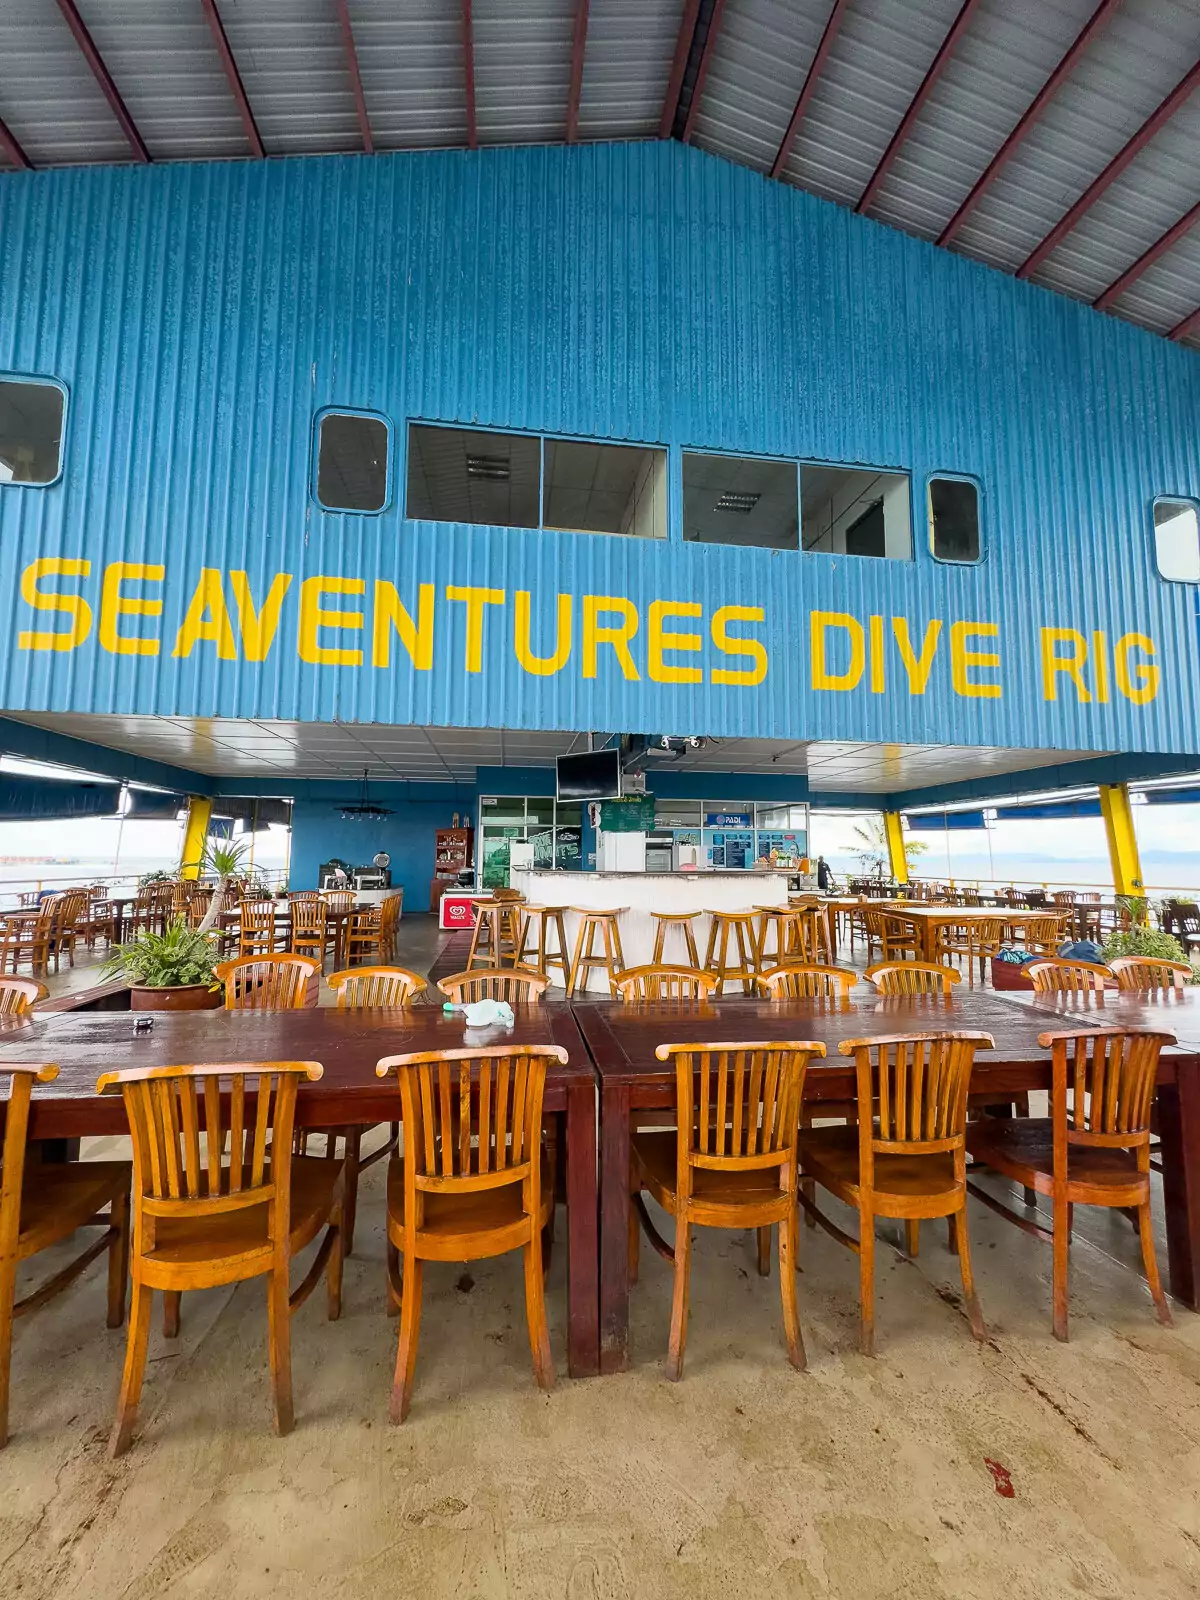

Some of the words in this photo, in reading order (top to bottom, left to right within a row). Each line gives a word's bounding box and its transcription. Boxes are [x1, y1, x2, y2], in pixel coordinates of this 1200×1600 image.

[18, 557, 768, 686] SEAVENTURES
[810, 610, 1002, 698] DIVE
[1041, 626, 1160, 706] RIG
[725, 816, 741, 824] PADI
